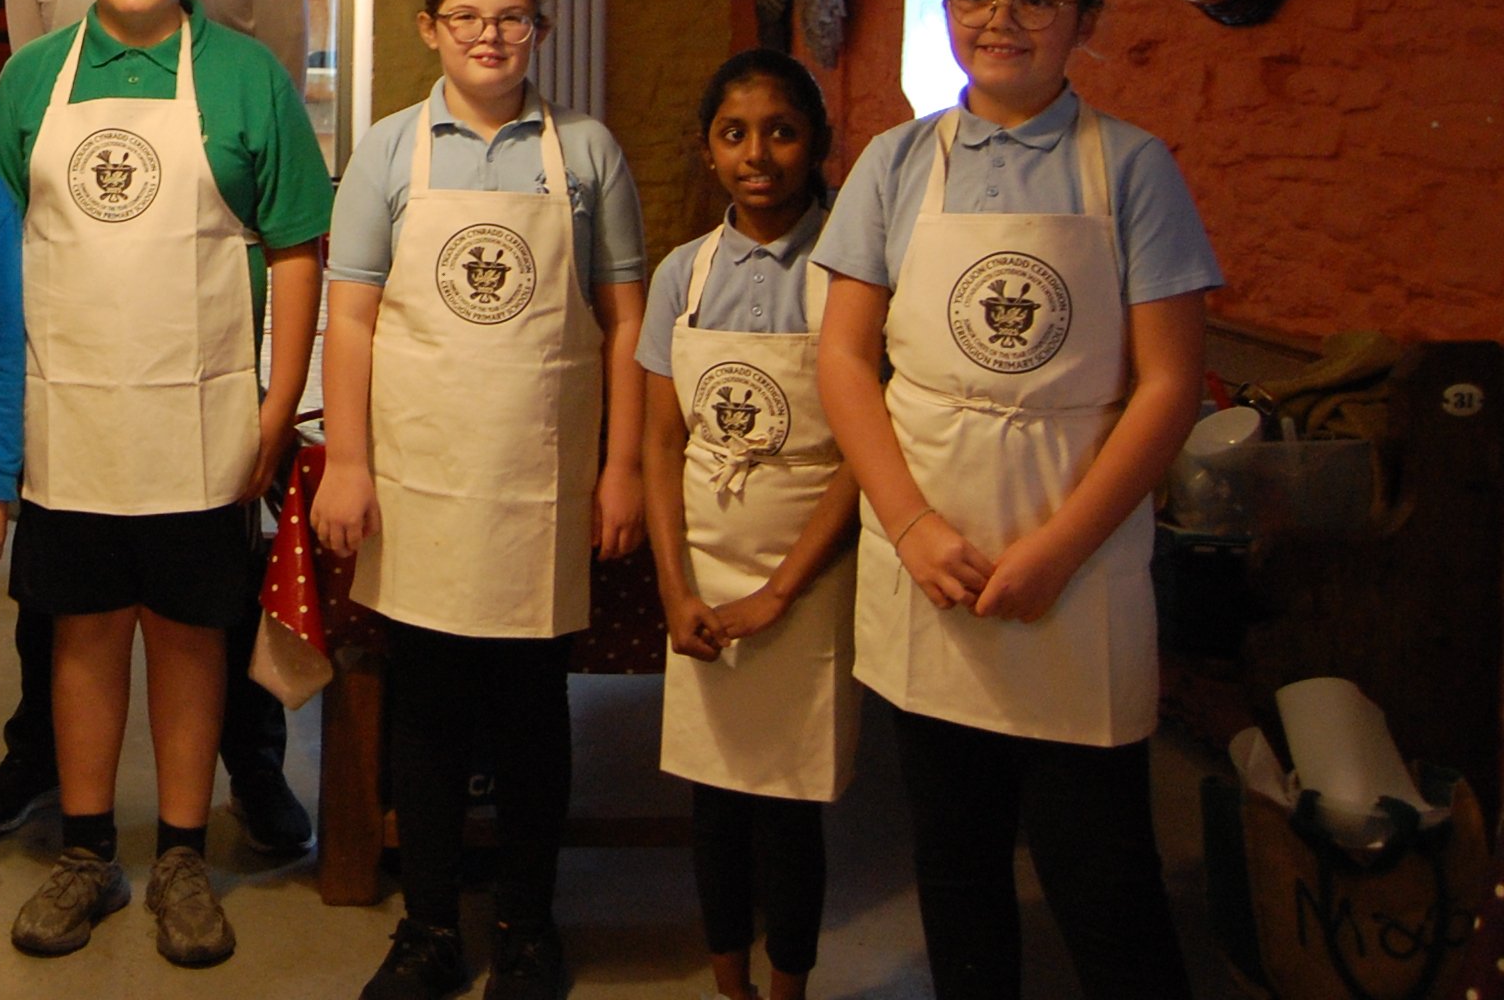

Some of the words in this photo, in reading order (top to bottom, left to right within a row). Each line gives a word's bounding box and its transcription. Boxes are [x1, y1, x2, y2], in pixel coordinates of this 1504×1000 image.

[953, 263, 987, 306] YSGOLION
[984, 256, 1031, 271] CYNRADD
[1030, 261, 1068, 311] CEREDIGION
[952, 319, 992, 365] CEREDIGION
[991, 356, 1035, 370] PRIMARY
